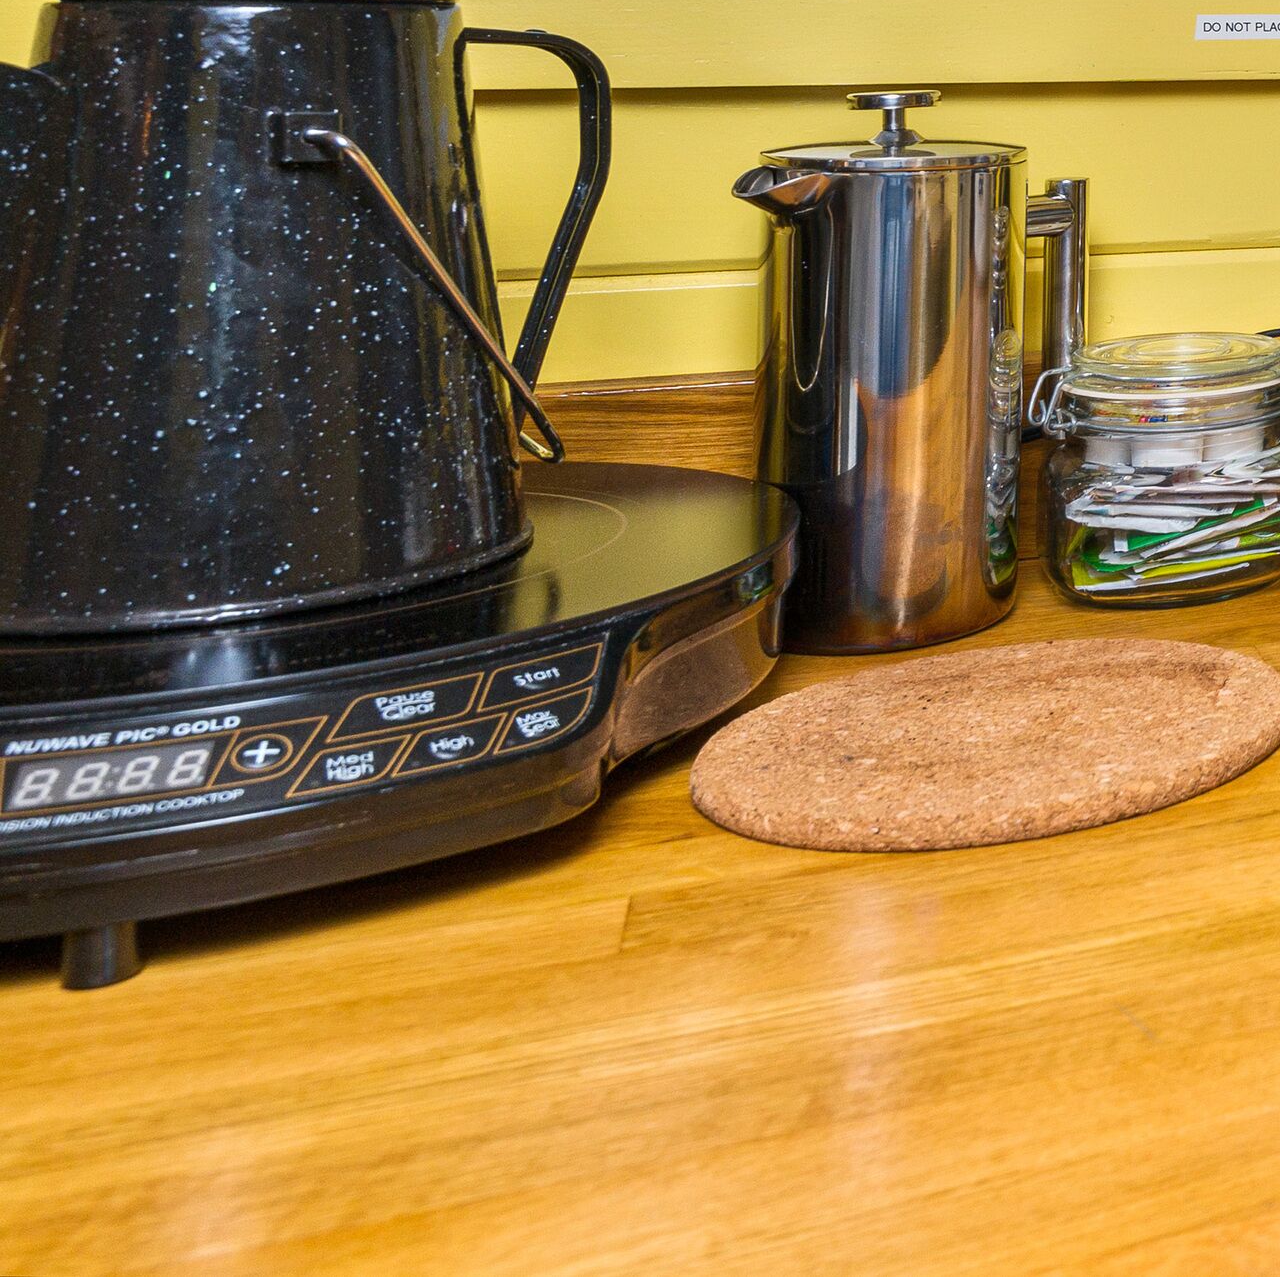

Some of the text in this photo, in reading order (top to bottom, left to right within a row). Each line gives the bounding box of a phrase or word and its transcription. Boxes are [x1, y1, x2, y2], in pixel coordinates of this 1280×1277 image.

[1203, 22, 1221, 32] DO
[1225, 22, 1251, 32] NOT
[513, 666, 561, 688] Start
[374, 690, 435, 710] Pause
[381, 700, 436, 721] Clear
[4, 732, 112, 755] NUWAVE
[172, 715, 241, 737] GOLD
[429, 734, 475, 756] High
[325, 751, 374, 769] Med
[326, 761, 375, 781] High
[51, 802, 154, 828] INDUCTION
[154, 788, 245, 814] COOKTOP
